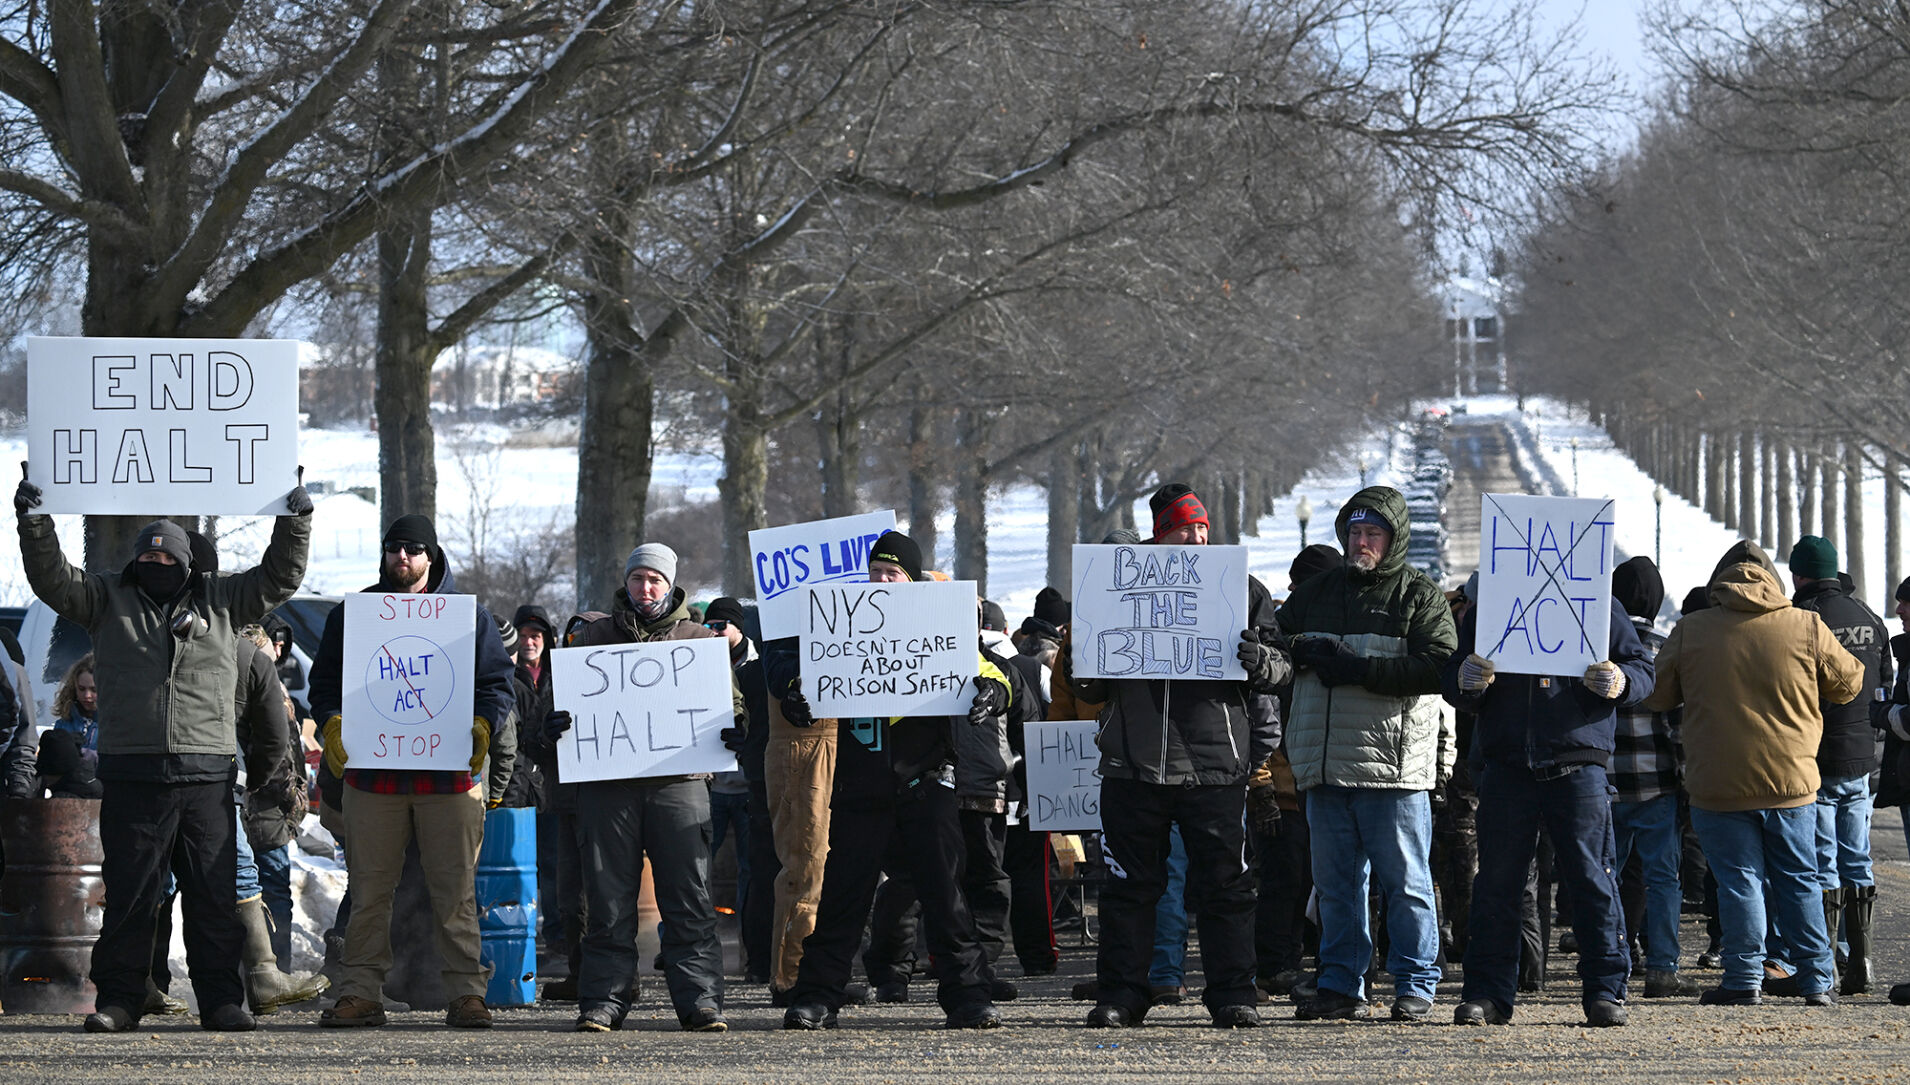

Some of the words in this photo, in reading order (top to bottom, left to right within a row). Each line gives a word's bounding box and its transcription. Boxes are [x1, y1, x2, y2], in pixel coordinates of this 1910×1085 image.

[92, 351, 254, 411] END
[53, 424, 269, 484] HALT
[1491, 516, 1615, 581] HALT
[756, 544, 810, 595] CO'S
[1113, 546, 1202, 590] BACK
[379, 594, 447, 621] STOP
[810, 588, 890, 638] NYS
[1120, 591, 1198, 629] THE
[1498, 597, 1597, 655] ACT
[379, 654, 434, 681] HALT
[810, 636, 901, 662] DOESN'T
[906, 635, 957, 654] CARE
[861, 654, 931, 676] ABOUT
[1097, 629, 1224, 679] BLUE
[581, 646, 696, 697] STOP
[818, 675, 896, 702] PRISON
[394, 688, 426, 712] ACT
[373, 733, 441, 758] STOP
[574, 708, 711, 764] HALT
[1039, 728, 1098, 765] HAL
[1072, 767, 1101, 789] IS
[1037, 792, 1098, 823] DANG
